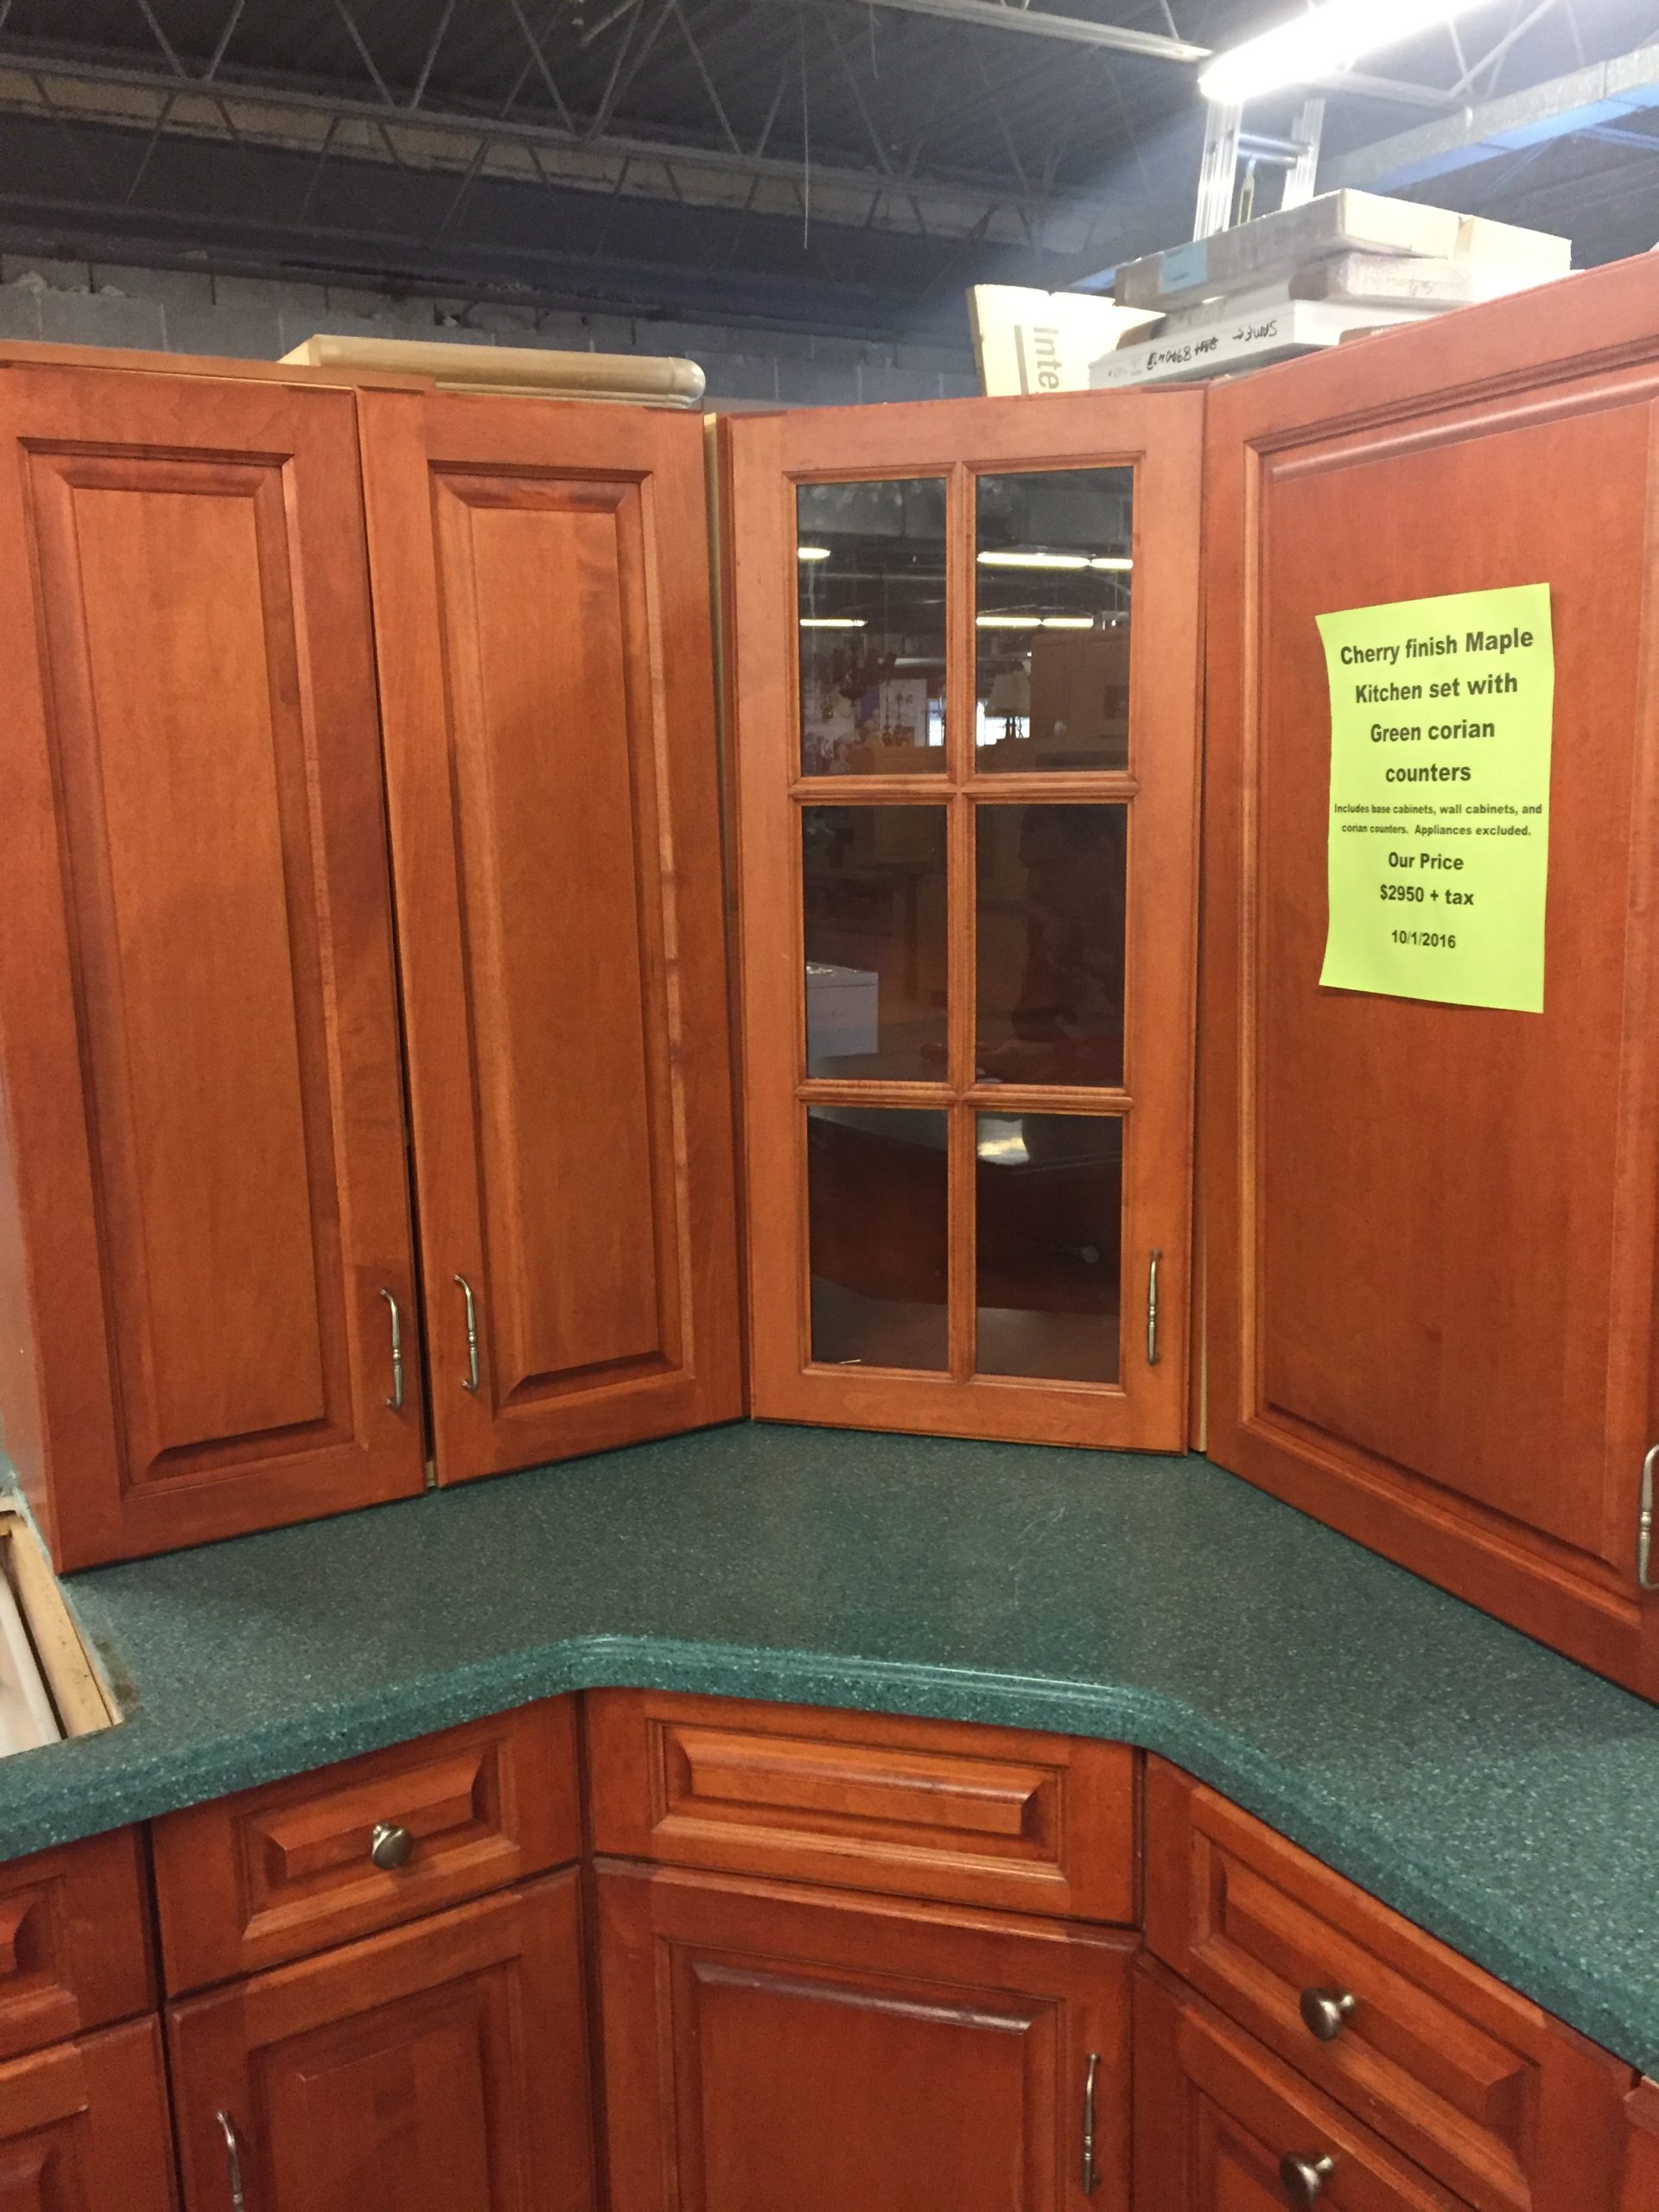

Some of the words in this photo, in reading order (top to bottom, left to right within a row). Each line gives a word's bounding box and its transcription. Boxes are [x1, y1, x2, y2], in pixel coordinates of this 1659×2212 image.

[1340, 645, 1401, 665] Cherry
[1405, 634, 1458, 659] finish
[1465, 626, 1534, 655] Maple
[1355, 682, 1423, 704] Kitchen
[1428, 677, 1460, 699] set
[1466, 672, 1518, 696] with
[1370, 723, 1421, 743] Green
[1427, 718, 1495, 741] corian
[1385, 763, 1471, 783] counters
[1334, 804, 1370, 814] Includes
[1371, 804, 1391, 814] base
[1392, 804, 1437, 816] cabinets,
[1440, 804, 1463, 815] wall
[1465, 804, 1519, 817] cabinets,
[1521, 804, 1542, 815] and
[1341, 824, 1368, 833] corian
[1369, 824, 1409, 835] counters.
[1414, 823, 1472, 837] Appliances
[1475, 824, 1531, 836] excluded.
[1388, 851, 1415, 868] Our
[1420, 852, 1465, 871] Price
[1379, 883, 1425, 903] $2950
[1429, 889, 1440, 902] +
[1445, 889, 1474, 906] tax
[1391, 929, 1456, 949] 10/1/2016
